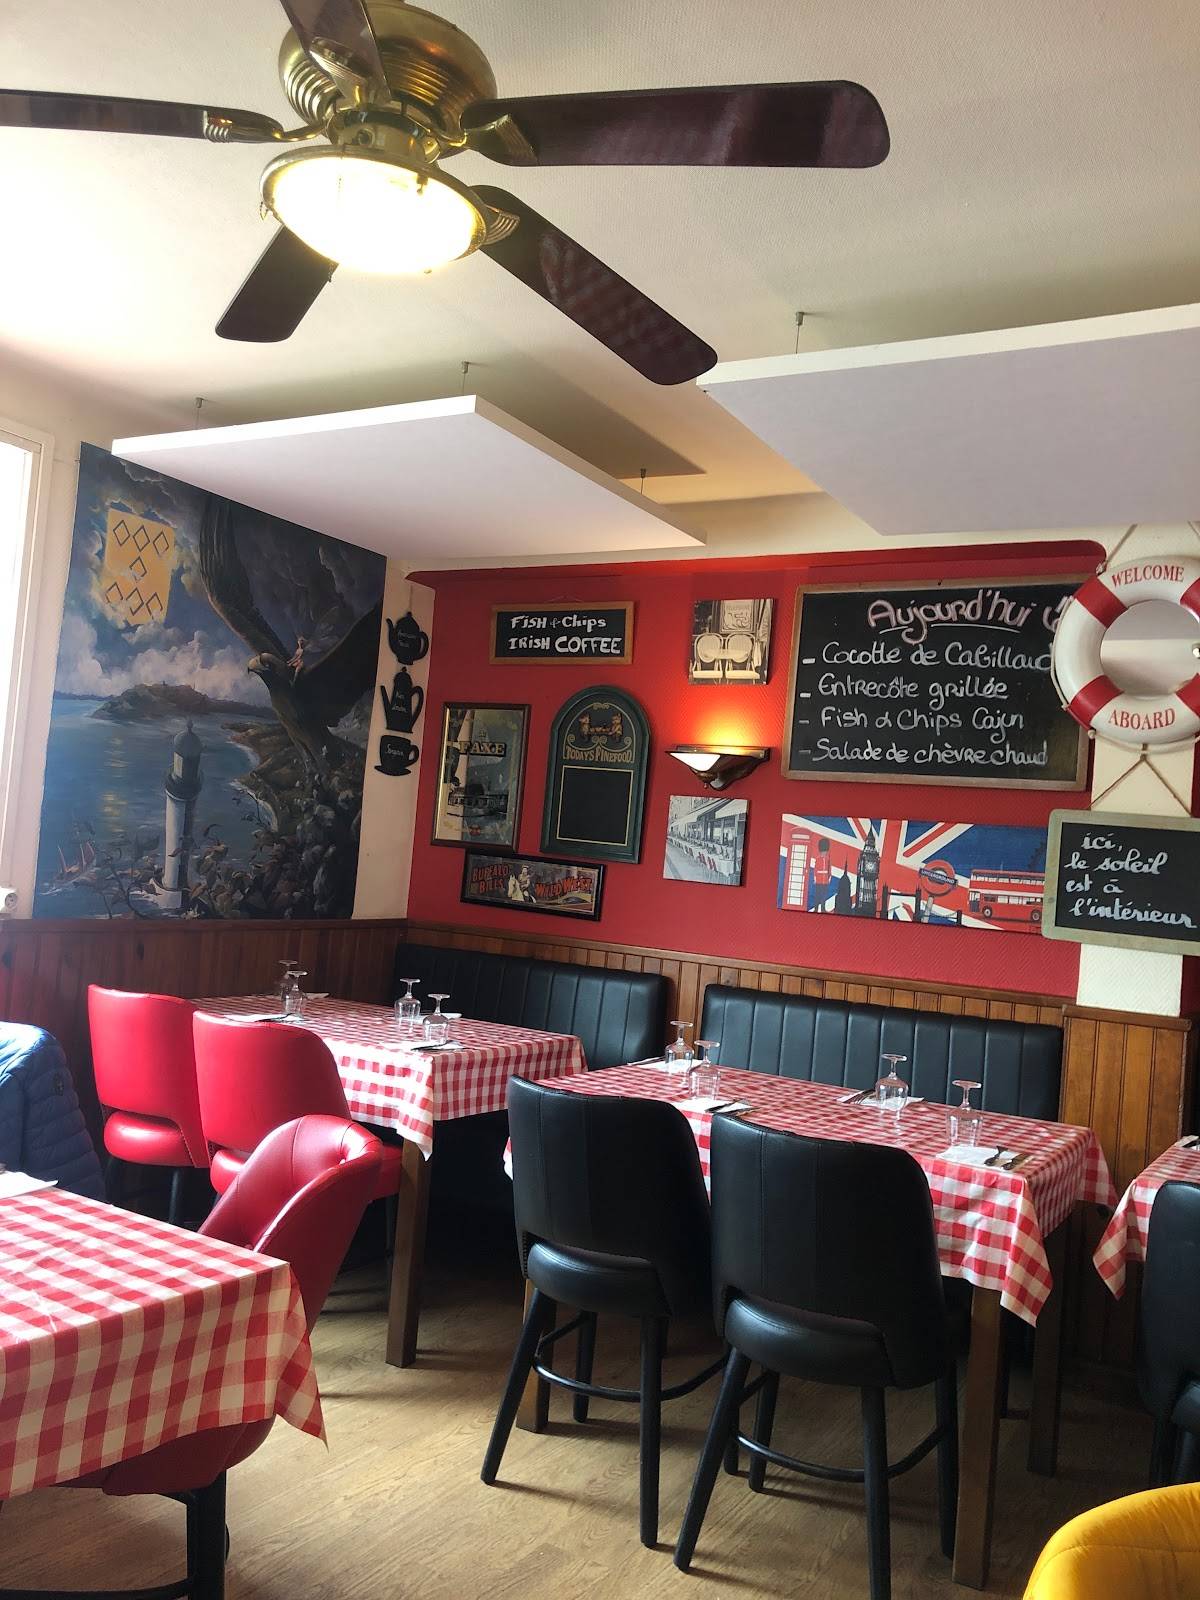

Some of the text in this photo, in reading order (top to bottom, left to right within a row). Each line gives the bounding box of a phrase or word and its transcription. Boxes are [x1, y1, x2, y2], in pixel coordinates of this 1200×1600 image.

[1111, 564, 1185, 588] WELCOME
[868, 589, 1037, 645] Aujourd'hui
[554, 635, 622, 654] COFFEE
[822, 641, 902, 664] Cocotte
[910, 644, 940, 666] de
[929, 675, 1009, 710] grillée
[820, 706, 868, 728] Fish
[896, 708, 963, 736] Chips
[1108, 707, 1176, 730] ABOARD
[459, 741, 505, 756] FAXE
[812, 738, 1048, 766] Salade de chèvre chaud
[1064, 848, 1168, 875] le soleil
[1065, 873, 1093, 893] est
[1068, 897, 1197, 929] l'intérieur
